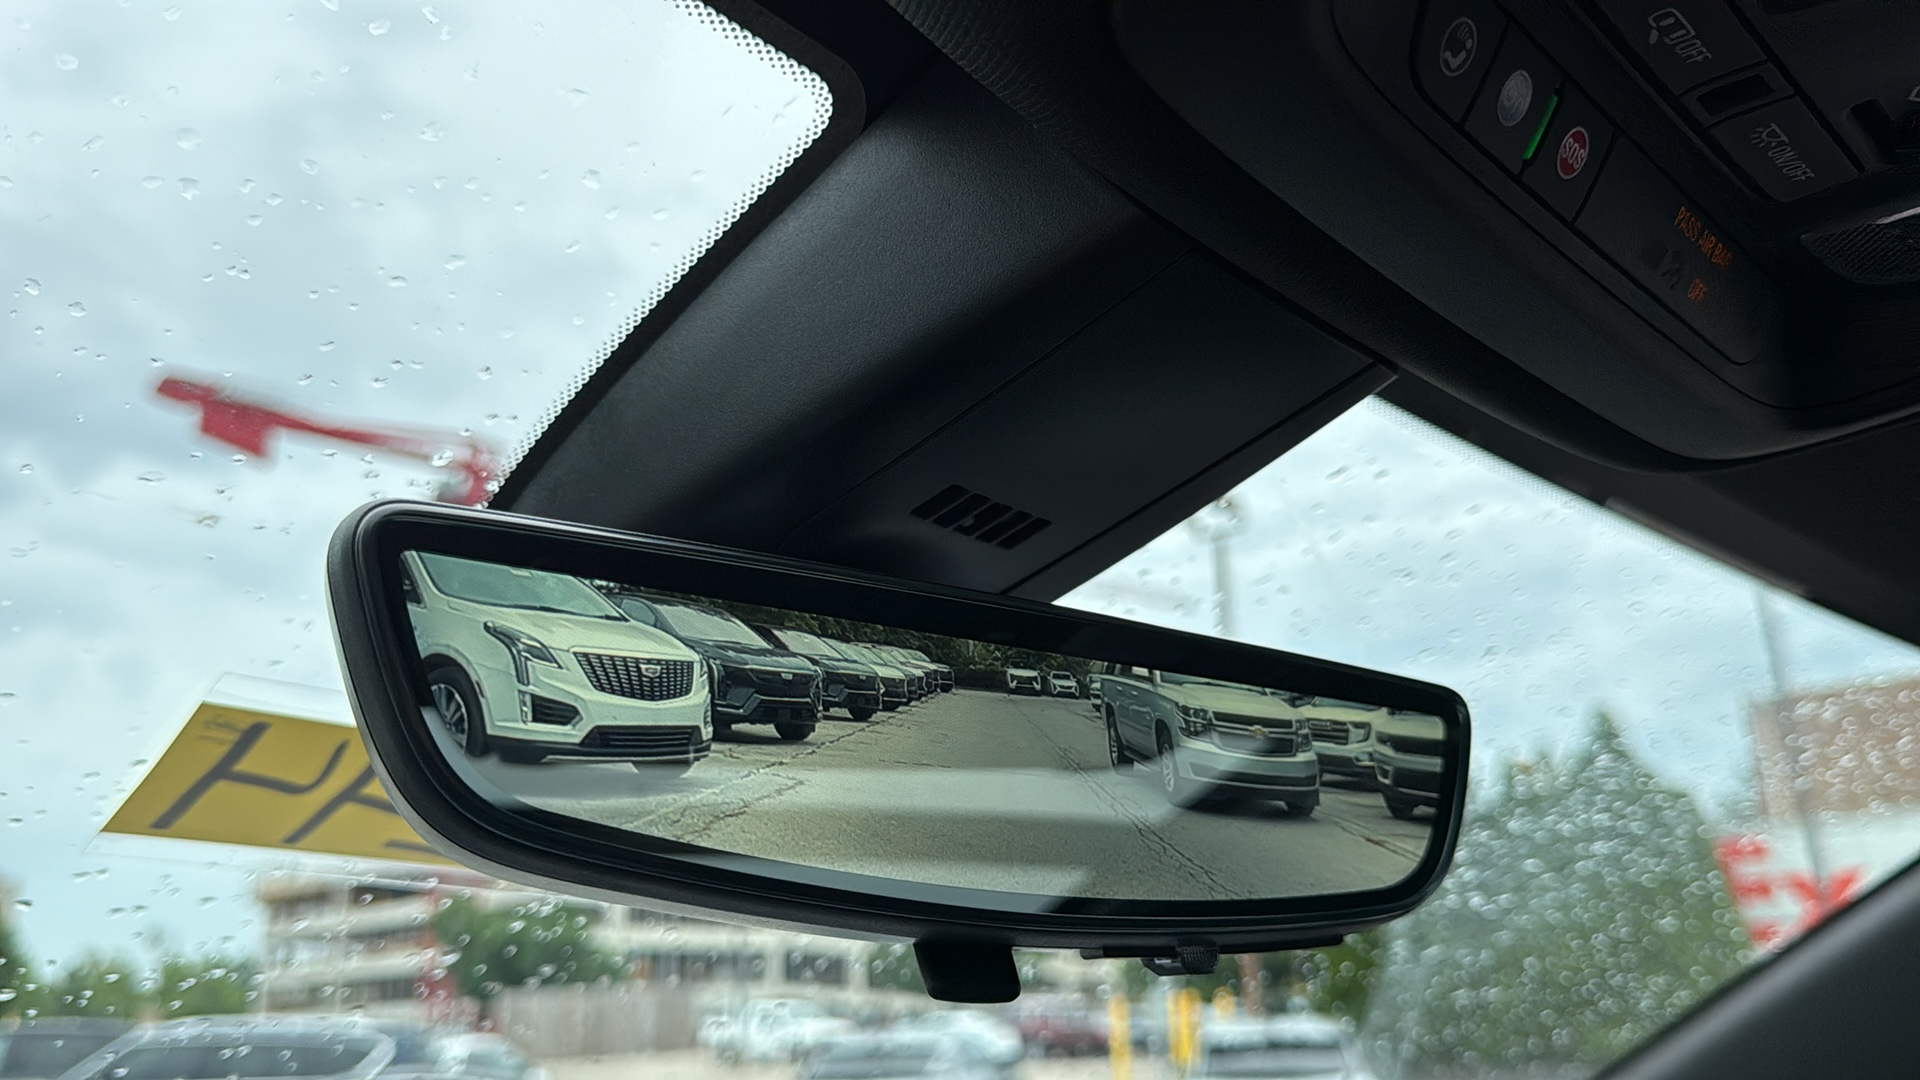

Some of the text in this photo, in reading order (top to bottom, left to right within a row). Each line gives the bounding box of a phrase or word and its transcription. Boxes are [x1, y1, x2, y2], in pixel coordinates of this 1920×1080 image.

[1675, 39, 1713, 63] OFF
[1561, 138, 1585, 169] SOS
[1768, 146, 1815, 181] ON/OFF
[1674, 207, 1702, 241] PASS
[1698, 229, 1717, 257] AIR
